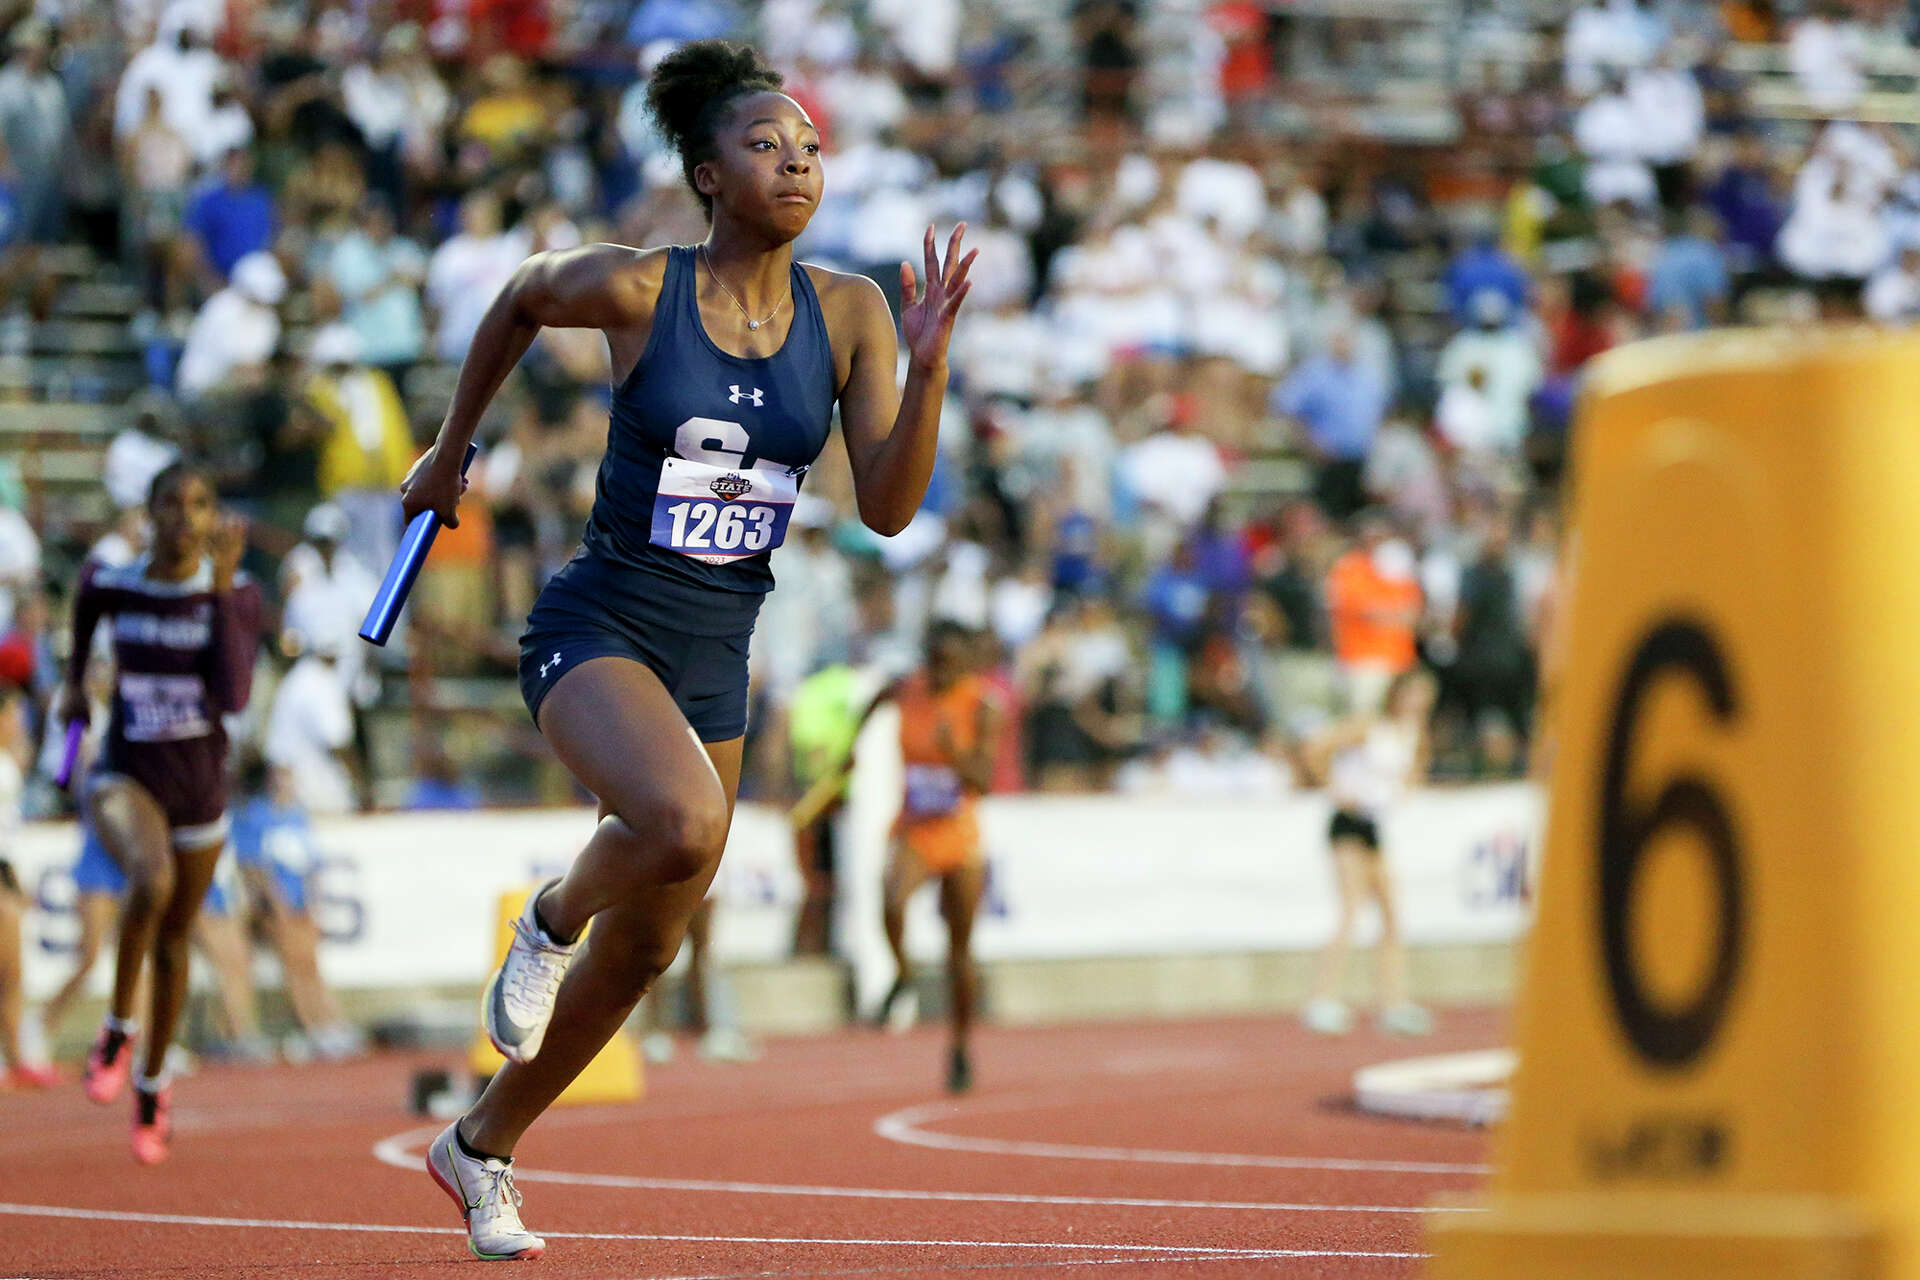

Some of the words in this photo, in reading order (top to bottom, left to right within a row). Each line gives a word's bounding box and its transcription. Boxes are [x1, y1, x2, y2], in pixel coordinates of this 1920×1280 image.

[710, 481, 752, 492] STATE
[667, 502, 776, 550] 1263
[1595, 613, 1743, 1067] 6
